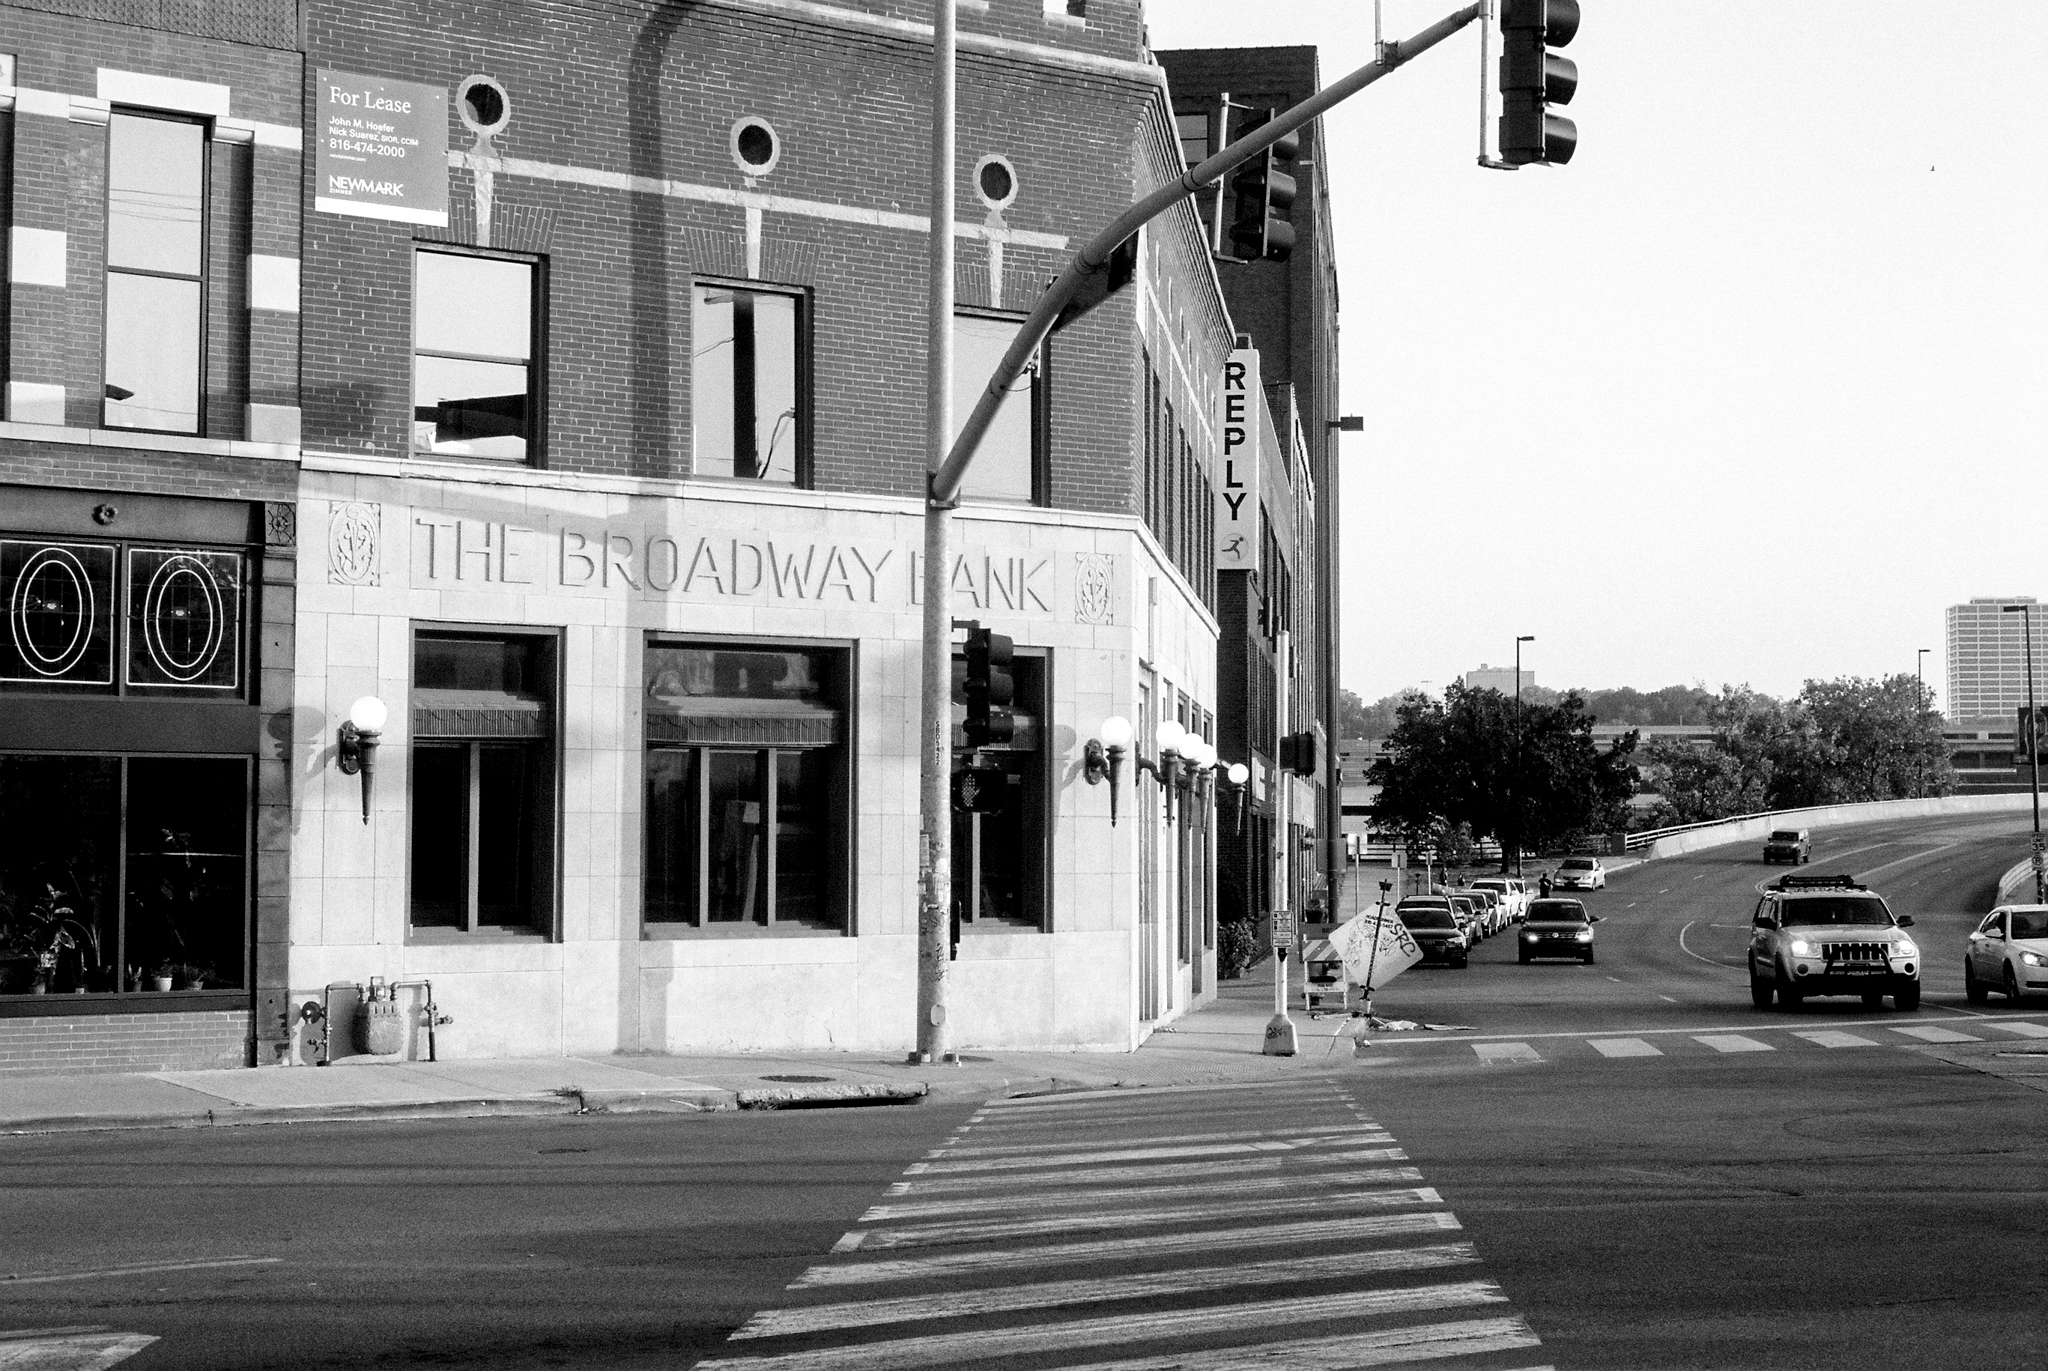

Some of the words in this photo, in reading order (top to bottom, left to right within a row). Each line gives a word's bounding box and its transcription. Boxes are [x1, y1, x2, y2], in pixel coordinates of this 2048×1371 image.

[329, 86, 360, 106] For
[364, 91, 412, 113] Lease
[329, 116, 351, 127] John
[353, 119, 364, 129] M.
[366, 121, 395, 132] Hoefer
[329, 126, 347, 136] Nick
[349, 129, 380, 142] Suarez,
[329, 138, 405, 158] 816-474-2000
[329, 174, 404, 197] NEWMARK
[329, 187, 352, 195] ZIMMER
[1222, 361, 1248, 521] REPLY
[415, 517, 534, 585] THE
[559, 526, 893, 603] BROADWAY
[2032, 843, 2046, 851] 35
